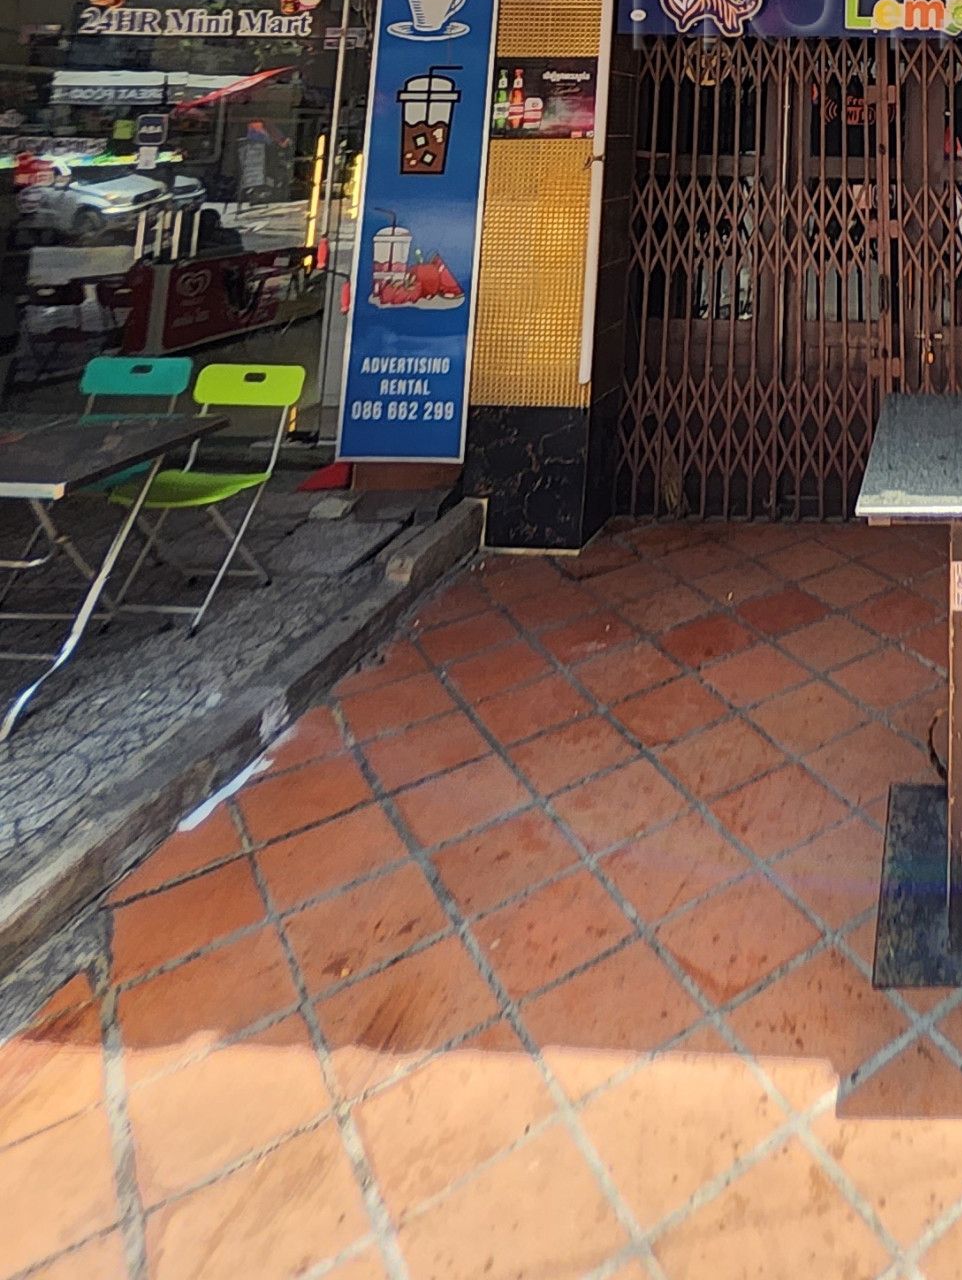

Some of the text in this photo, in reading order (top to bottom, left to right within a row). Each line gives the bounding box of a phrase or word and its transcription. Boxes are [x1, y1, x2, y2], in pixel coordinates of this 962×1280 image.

[165, 9, 233, 37] Mini
[237, 9, 313, 37] Mart
[360, 356, 451, 374] ADVERTISING
[379, 378, 431, 396] RENTAL
[422, 400, 455, 421] 299
